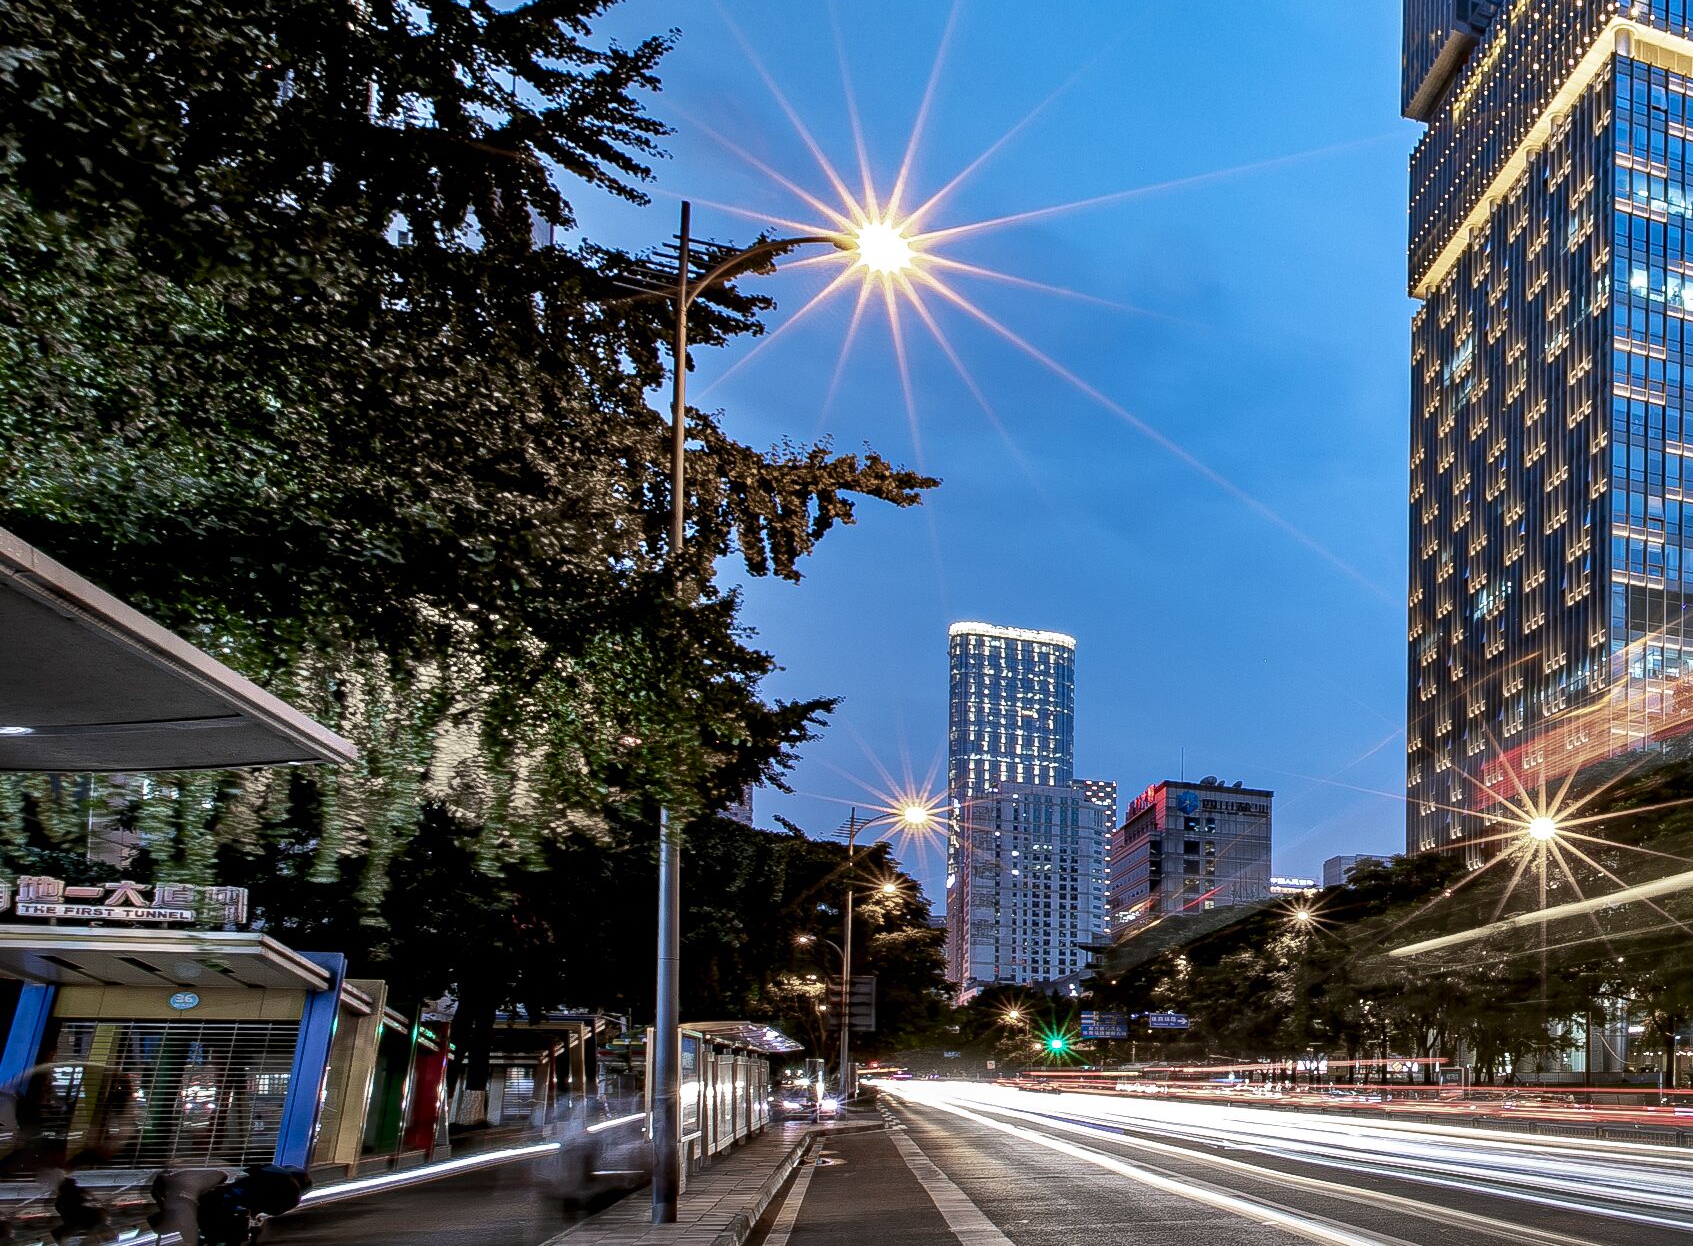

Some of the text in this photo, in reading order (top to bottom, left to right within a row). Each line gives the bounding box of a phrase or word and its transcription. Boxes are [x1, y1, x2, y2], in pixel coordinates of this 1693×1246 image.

[21, 904, 190, 920] THE FIRST TUNNEL
